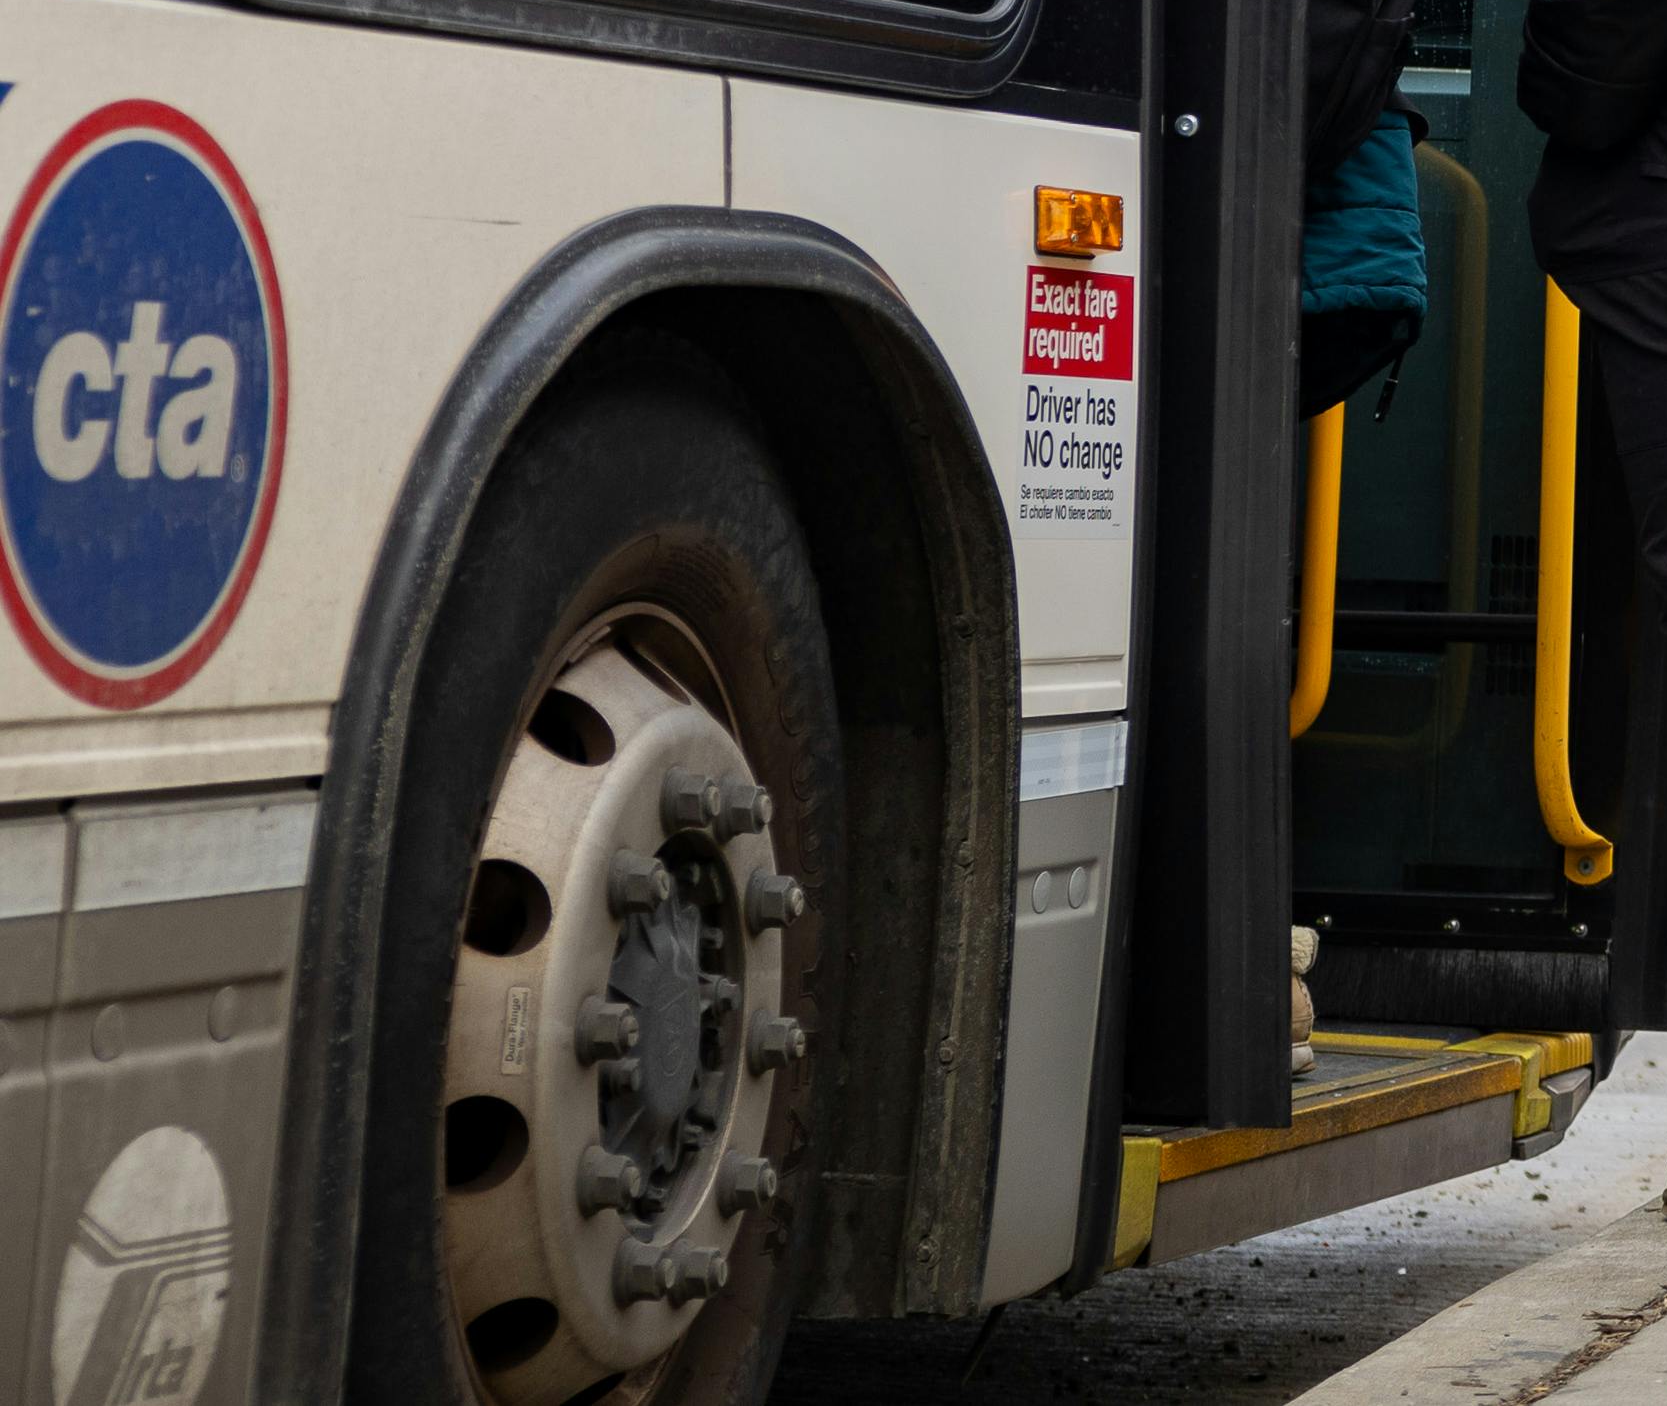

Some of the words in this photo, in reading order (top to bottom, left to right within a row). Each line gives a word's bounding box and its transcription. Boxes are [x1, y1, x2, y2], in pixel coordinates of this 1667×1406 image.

[1030, 274, 1080, 318] Exact
[1084, 279, 1118, 320] fare
[1028, 322, 1104, 369] required
[32, 301, 237, 483] cta
[1026, 384, 1081, 425] Driver
[1085, 389, 1116, 426] has
[1023, 429, 1054, 469] NO
[1059, 432, 1123, 480] change
[1020, 484, 1031, 500] Se
[1033, 485, 1064, 504] requiere
[1065, 486, 1090, 500] cambio
[1091, 487, 1114, 501] exacto
[1020, 504, 1028, 519] El
[1029, 504, 1054, 519] chofer
[1055, 505, 1067, 520] NO
[1068, 505, 1086, 520] tiene
[1087, 506, 1112, 521] cambio
